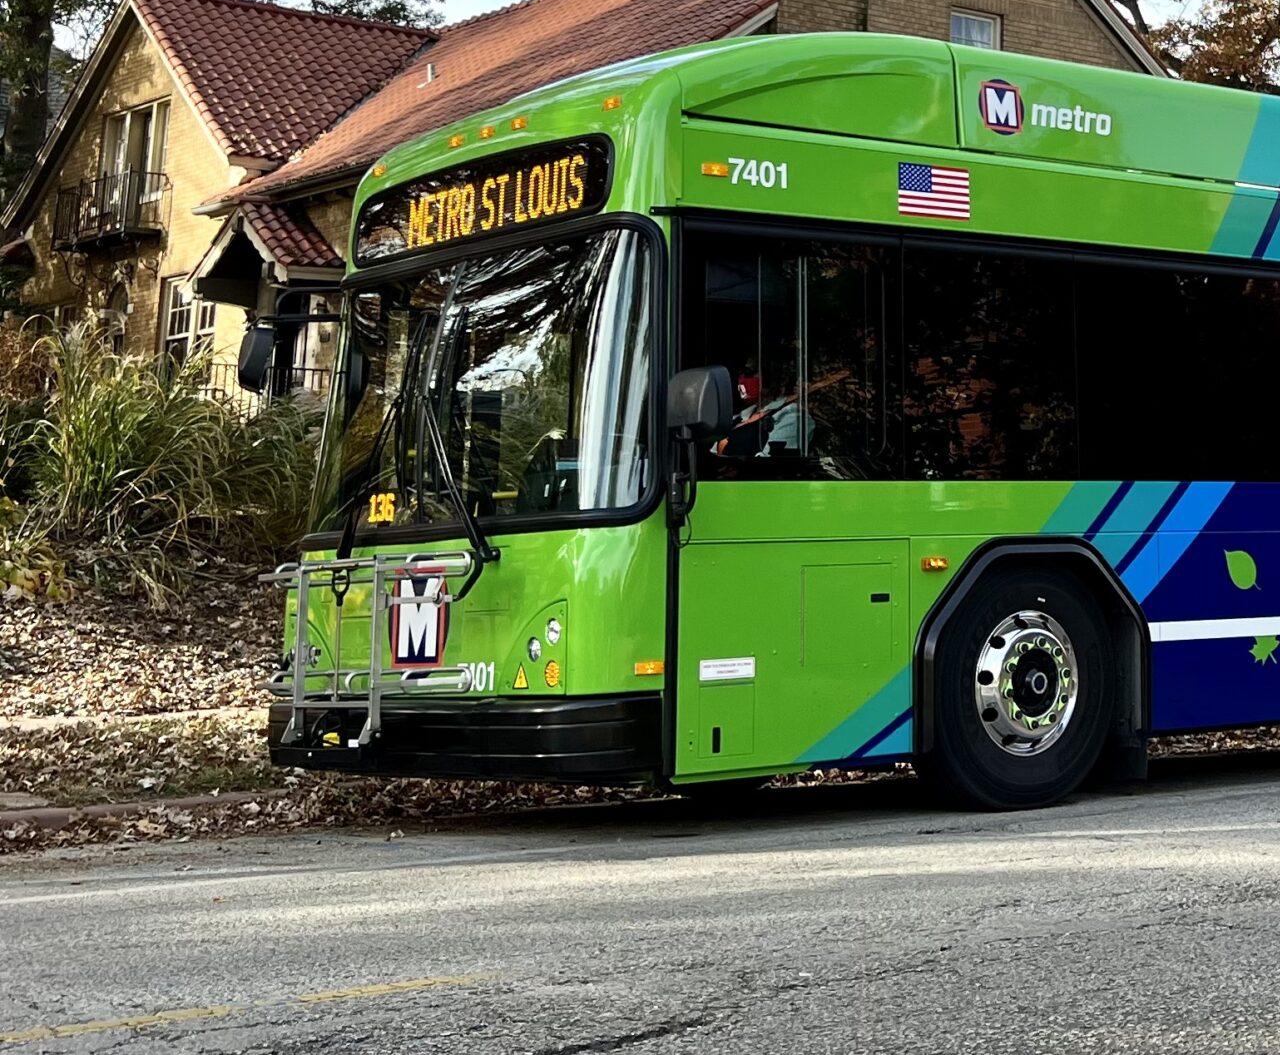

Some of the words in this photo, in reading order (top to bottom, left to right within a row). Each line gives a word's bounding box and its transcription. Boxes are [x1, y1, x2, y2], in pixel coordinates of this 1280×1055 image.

[985, 87, 1018, 127] M
[1031, 103, 1112, 136] metro
[728, 157, 788, 189] 7401
[408, 183, 476, 250] METRO
[480, 173, 510, 231] ST
[514, 154, 585, 224] LOUIS
[367, 492, 396, 522] 136
[398, 577, 440, 658] M
